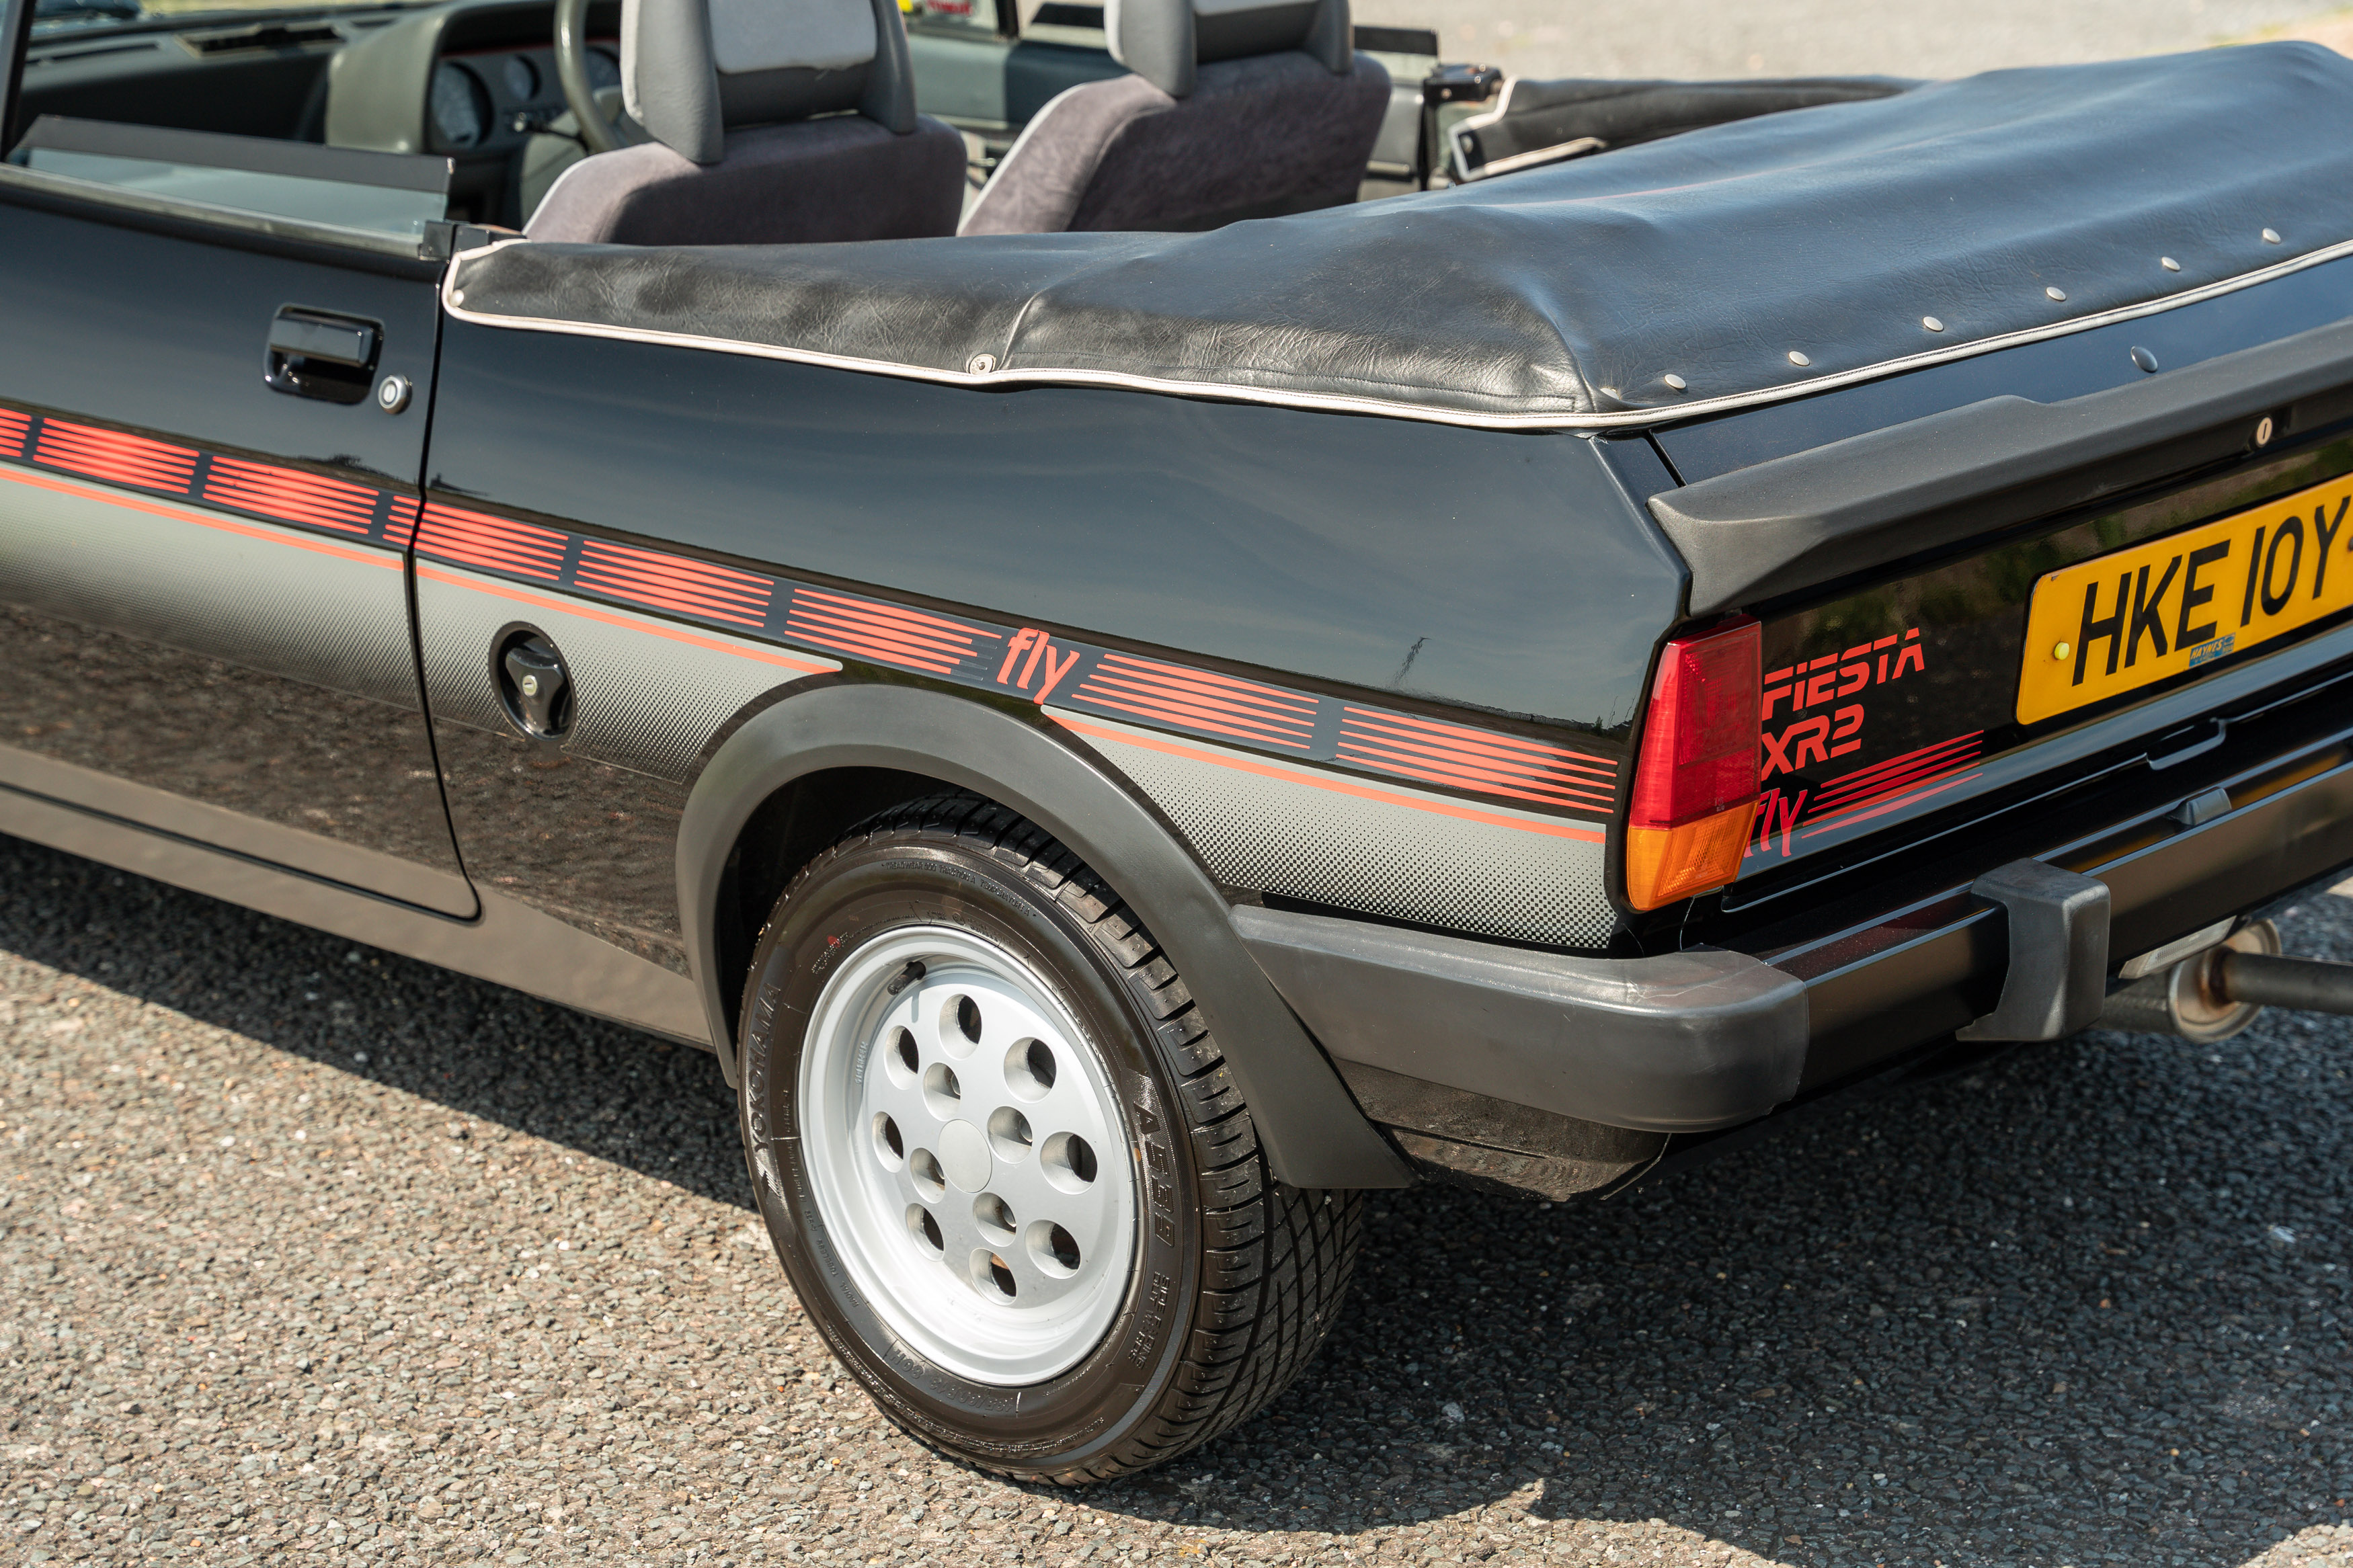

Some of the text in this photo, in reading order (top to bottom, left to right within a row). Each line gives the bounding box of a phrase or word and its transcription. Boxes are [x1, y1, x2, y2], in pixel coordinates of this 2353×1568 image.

[2071, 538, 2231, 687] HKE
[2190, 638, 2224, 660] HAYNES
[996, 627, 1080, 705] fly
[1762, 628, 1925, 721] FIESTA
[1761, 704, 1864, 782] XR2
[748, 983, 781, 1153] YOKOHAMA
